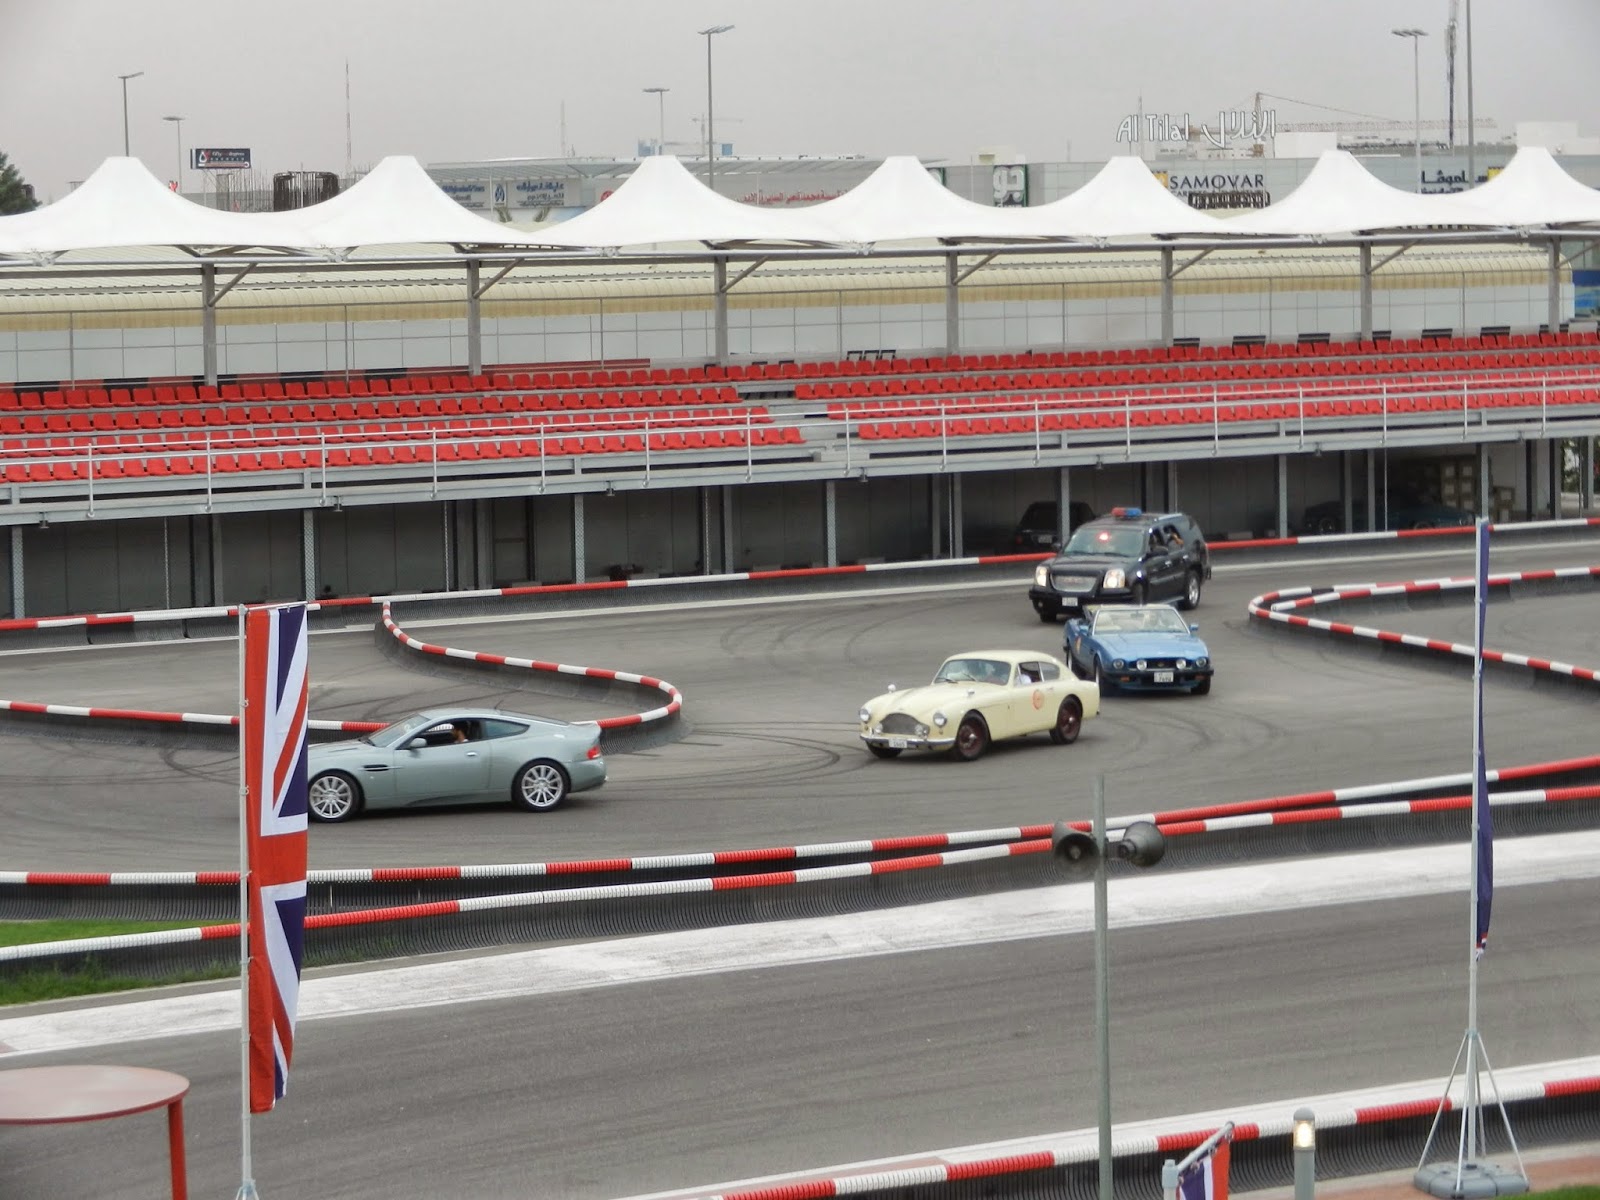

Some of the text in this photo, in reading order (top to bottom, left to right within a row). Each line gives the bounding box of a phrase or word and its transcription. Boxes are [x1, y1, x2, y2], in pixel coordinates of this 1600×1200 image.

[1116, 113, 1189, 142] Al Tilal
[1201, 110, 1275, 149] التلال
[1170, 174, 1264, 190] SAMOVAR
